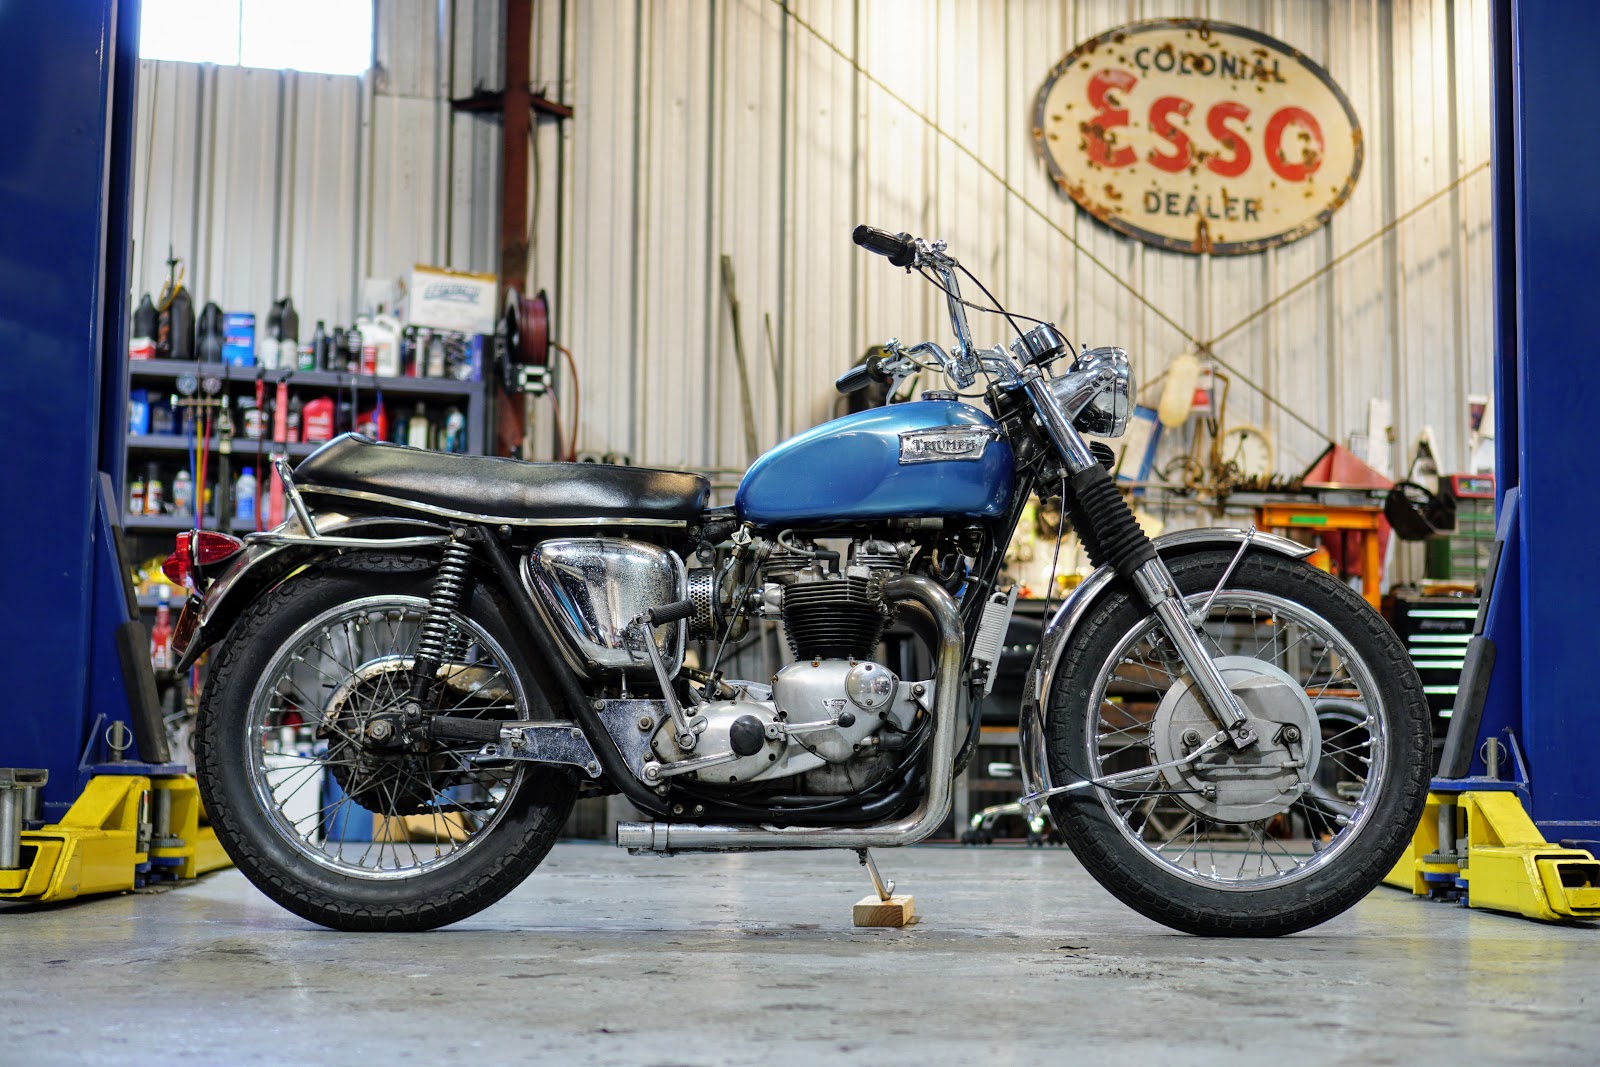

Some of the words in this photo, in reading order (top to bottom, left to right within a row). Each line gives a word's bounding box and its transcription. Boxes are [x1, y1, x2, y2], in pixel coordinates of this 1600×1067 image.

[1135, 47, 1285, 83] COLONIAL
[1086, 69, 1324, 182] ESSO
[1144, 191, 1260, 221] DEALER
[912, 438, 977, 452] TRIUMPH
